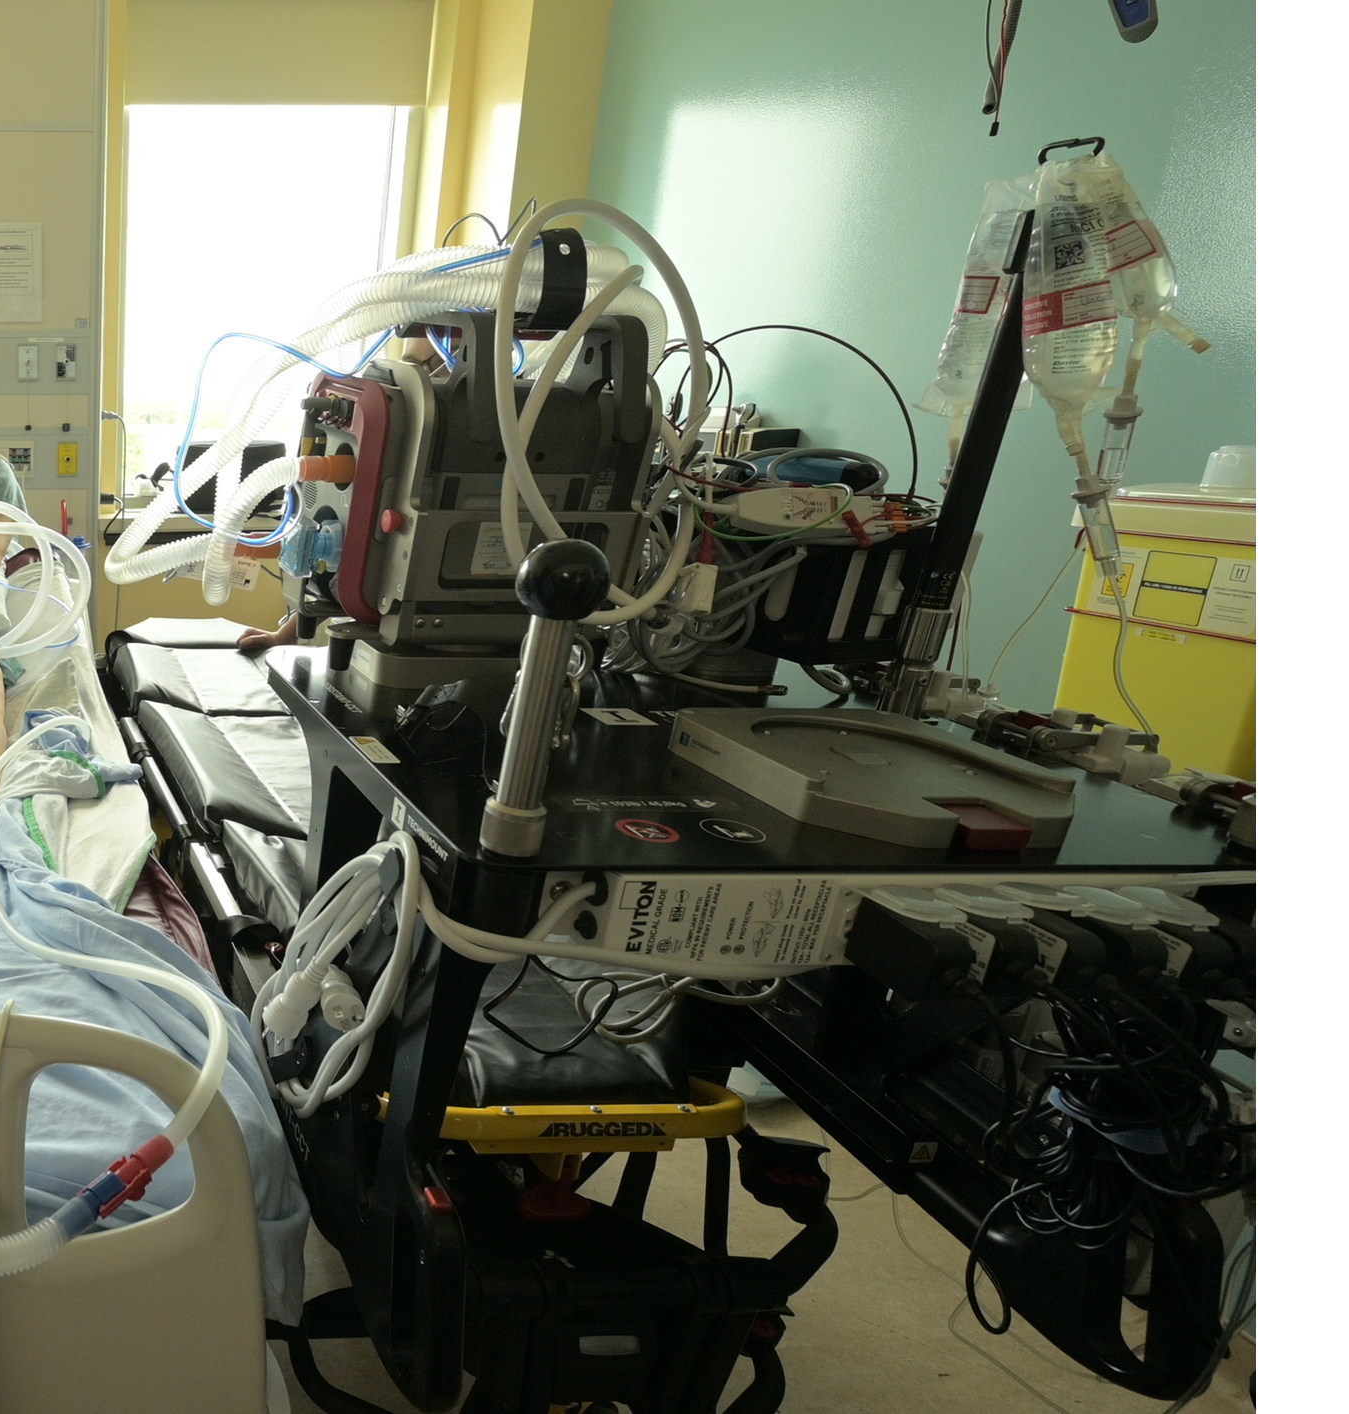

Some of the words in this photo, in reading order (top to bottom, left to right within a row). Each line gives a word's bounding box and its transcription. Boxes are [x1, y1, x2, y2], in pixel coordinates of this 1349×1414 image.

[407, 814, 448, 862] TECHNIMOUNT
[625, 881, 657, 954] EVITON
[646, 920, 660, 954] MEDICAL
[654, 889, 667, 917] GRADE
[685, 914, 698, 949] COMPLIANT
[694, 897, 703, 912] WITH
[696, 886, 714, 934] REQUIREMENTS
[699, 924, 711, 947] PATIENT
[707, 906, 716, 922] CARE
[712, 883, 722, 904] AREAS
[738, 901, 754, 940] PROTECTION
[809, 880, 827, 920] RECEPTACLES
[816, 887, 832, 923] RECEPTACLE
[726, 918, 735, 940] POWER
[552, 1122, 653, 1137] RUGGED
